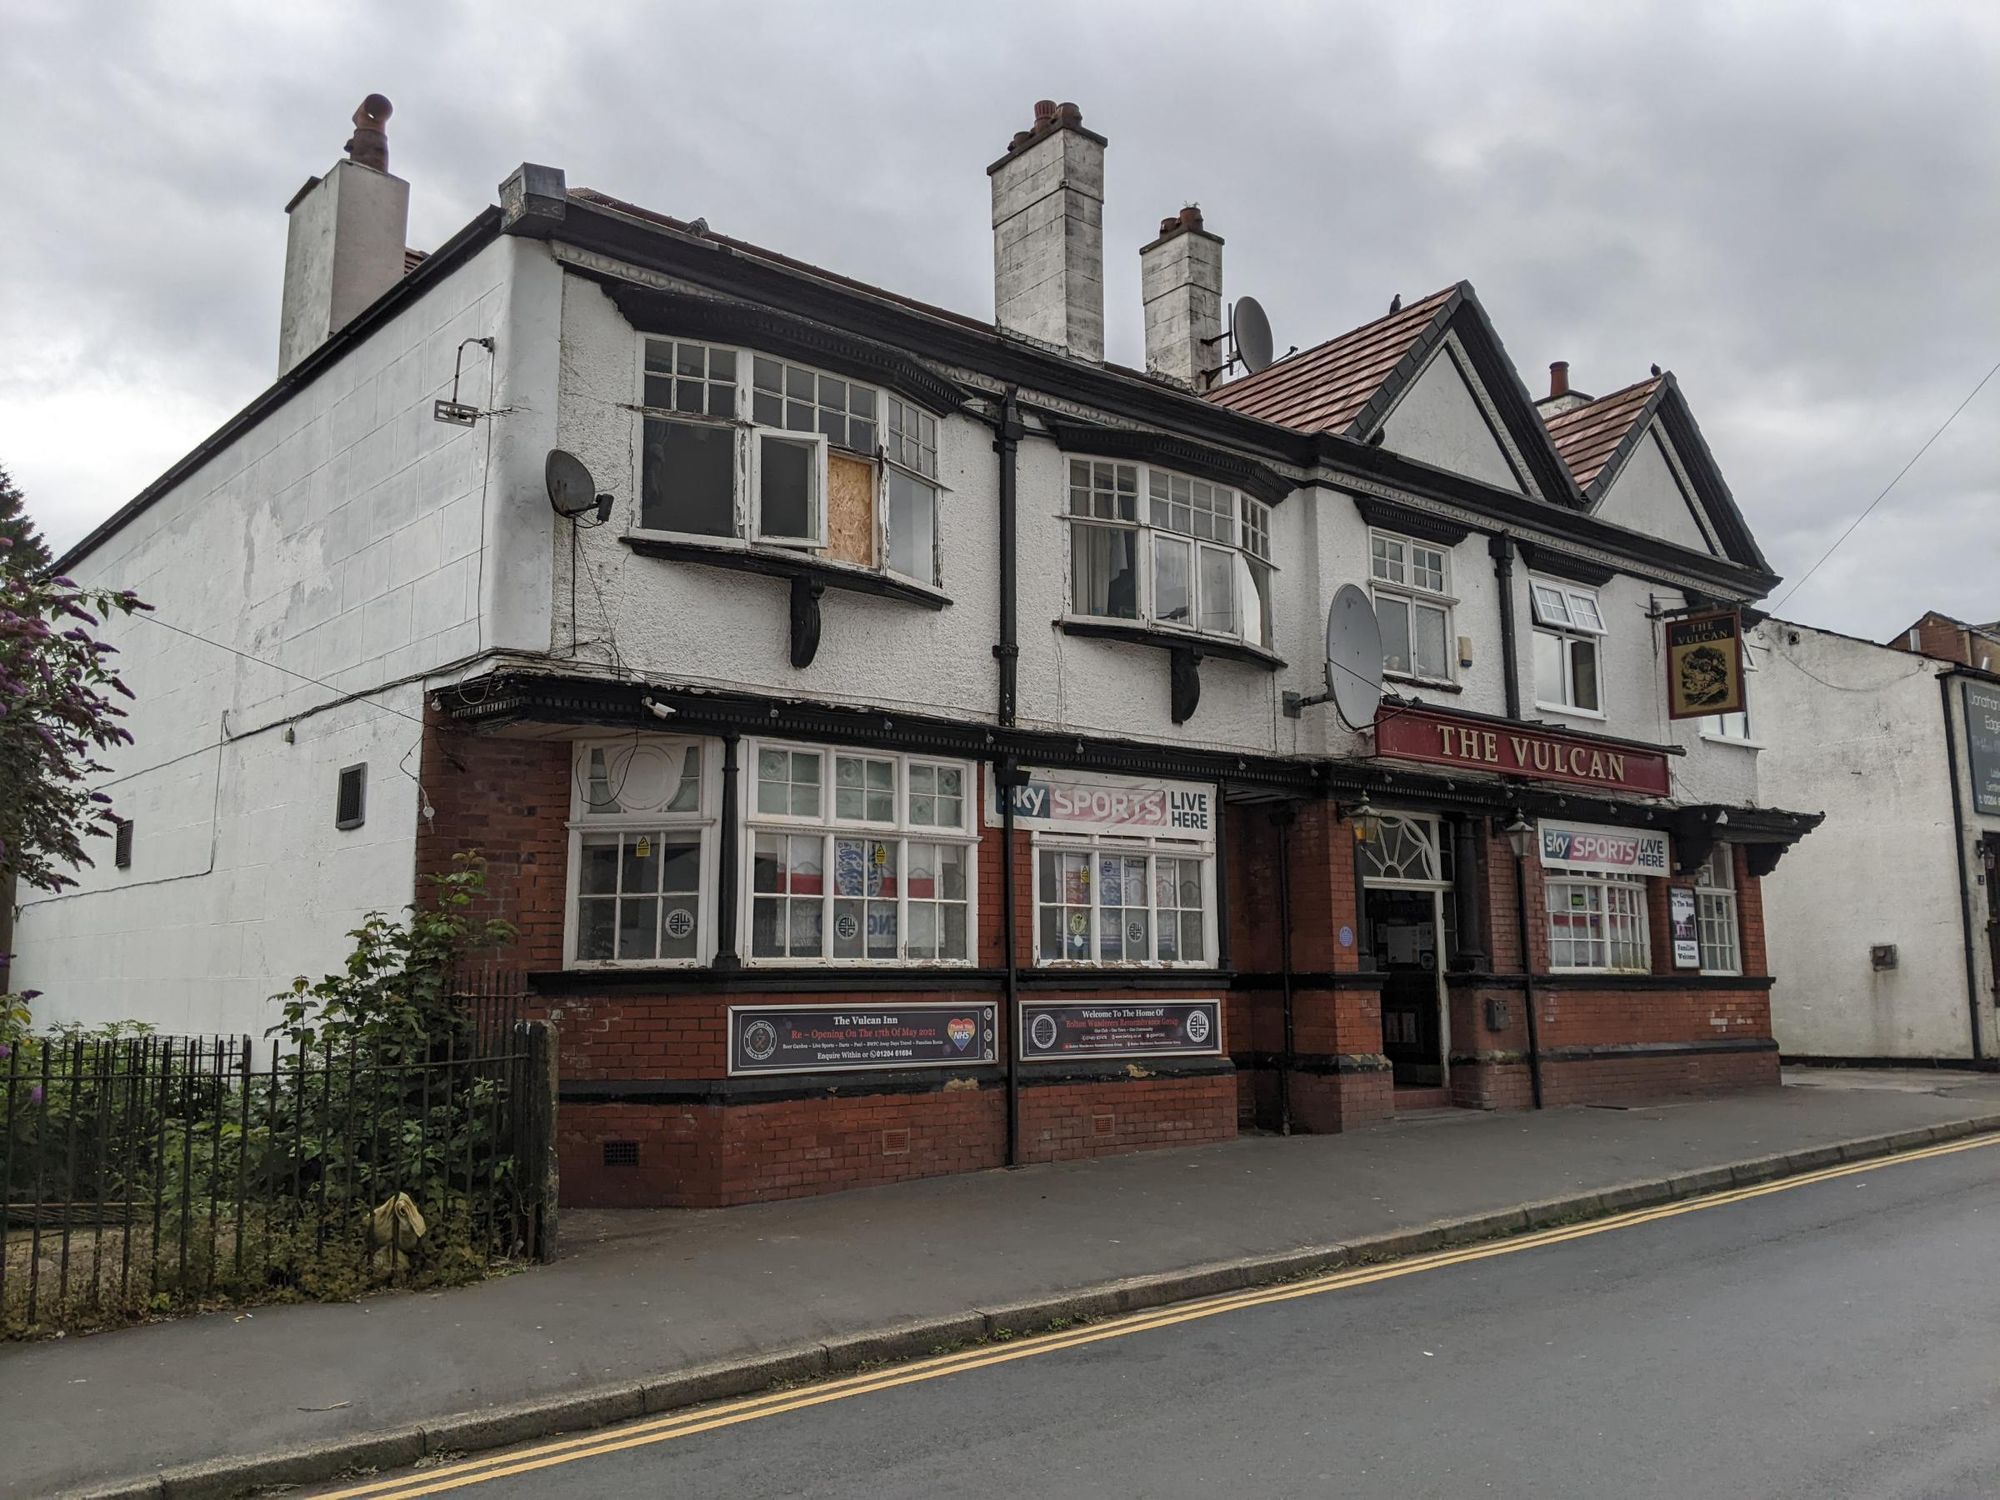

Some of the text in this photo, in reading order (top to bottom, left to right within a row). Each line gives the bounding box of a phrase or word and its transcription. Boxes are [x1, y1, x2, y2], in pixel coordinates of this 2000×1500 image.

[1692, 621, 1714, 632] THE
[1677, 630, 1728, 644] VULCAN
[1437, 724, 1625, 782] THE VULCAN
[1054, 789, 1164, 821] SPORTS
[1171, 790, 1207, 812] LIVE
[1171, 812, 1208, 829] HERE
[1546, 833, 1635, 861] sky SPORTS
[1640, 839, 1664, 854] LIVE
[1638, 853, 1664, 868] HERE
[1677, 952, 1696, 960] Welcome
[1082, 1008, 1164, 1018] Welcome To The Home Of
[833, 1015, 898, 1026] The Vulcan Inn
[791, 1030, 802, 1039] Re
[811, 1029, 844, 1040] Opening
[845, 1029, 857, 1038] On
[858, 1028, 873, 1037] The
[902, 1027, 917, 1038] May
[953, 1031, 969, 1040] NHS
[817, 1052, 840, 1061] Enquire
[842, 1050, 861, 1059] Within
[876, 1050, 894, 1058] 01204
